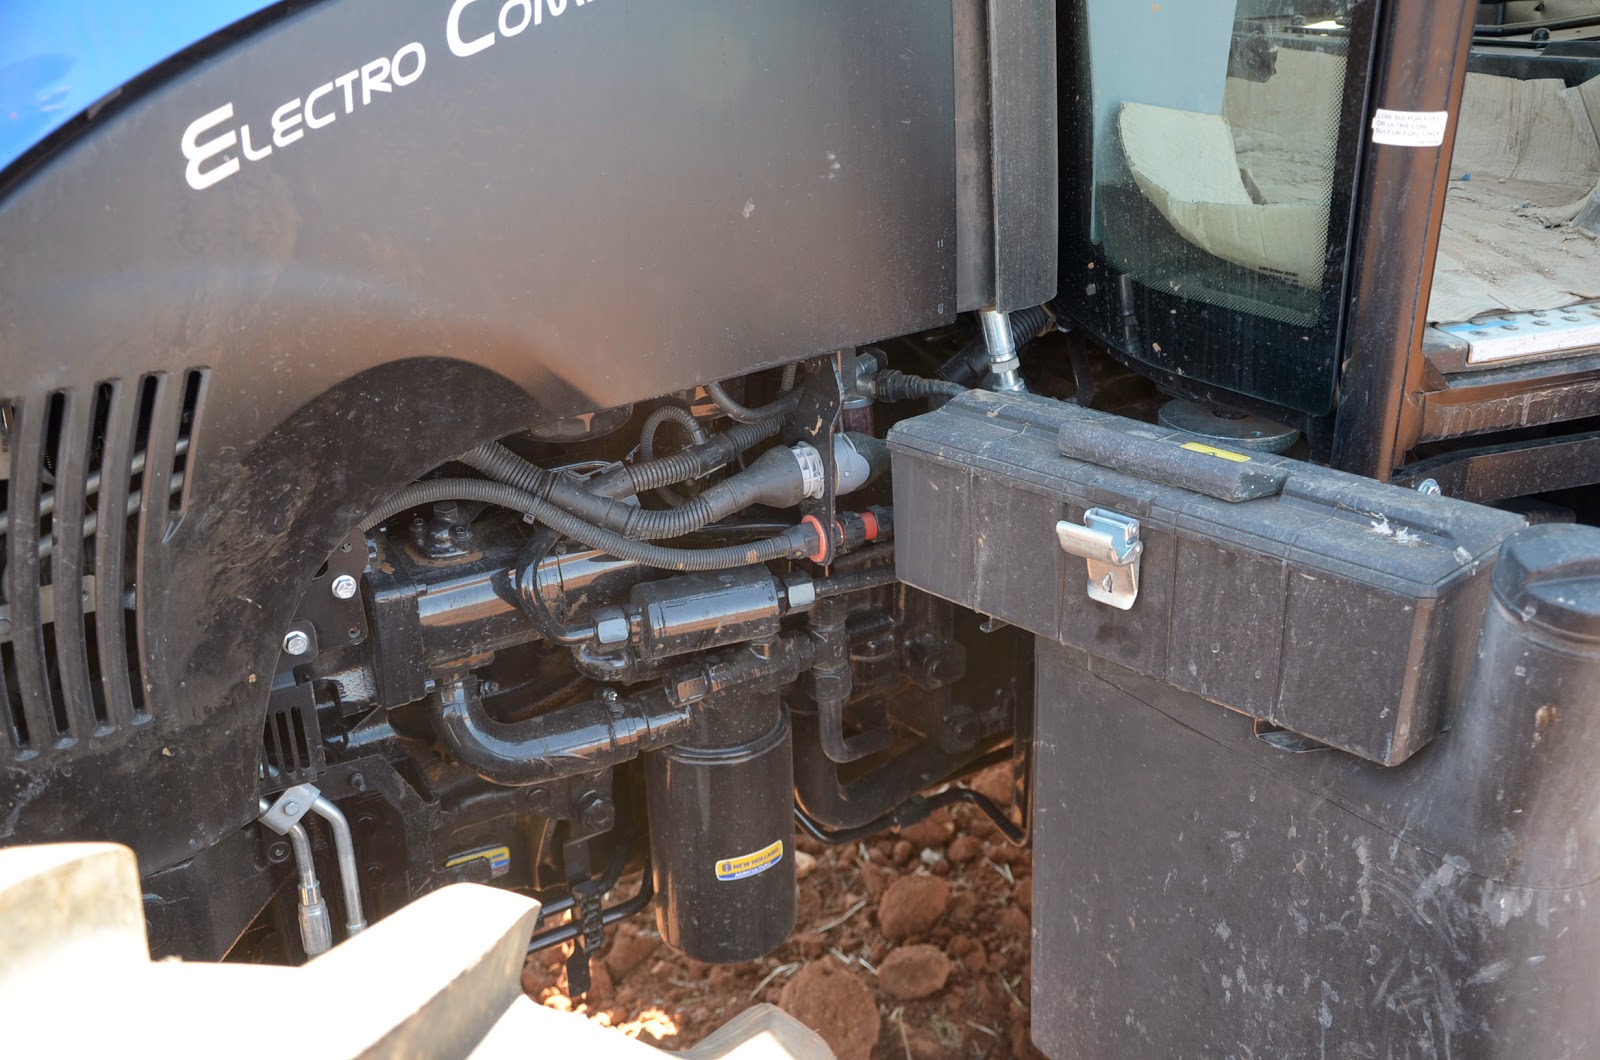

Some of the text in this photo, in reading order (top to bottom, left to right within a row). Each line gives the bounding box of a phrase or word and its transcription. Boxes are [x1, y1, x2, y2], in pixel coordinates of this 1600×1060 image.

[181, 42, 426, 190] ELECTRO
[733, 847, 779, 869] NEW HOLLAND
